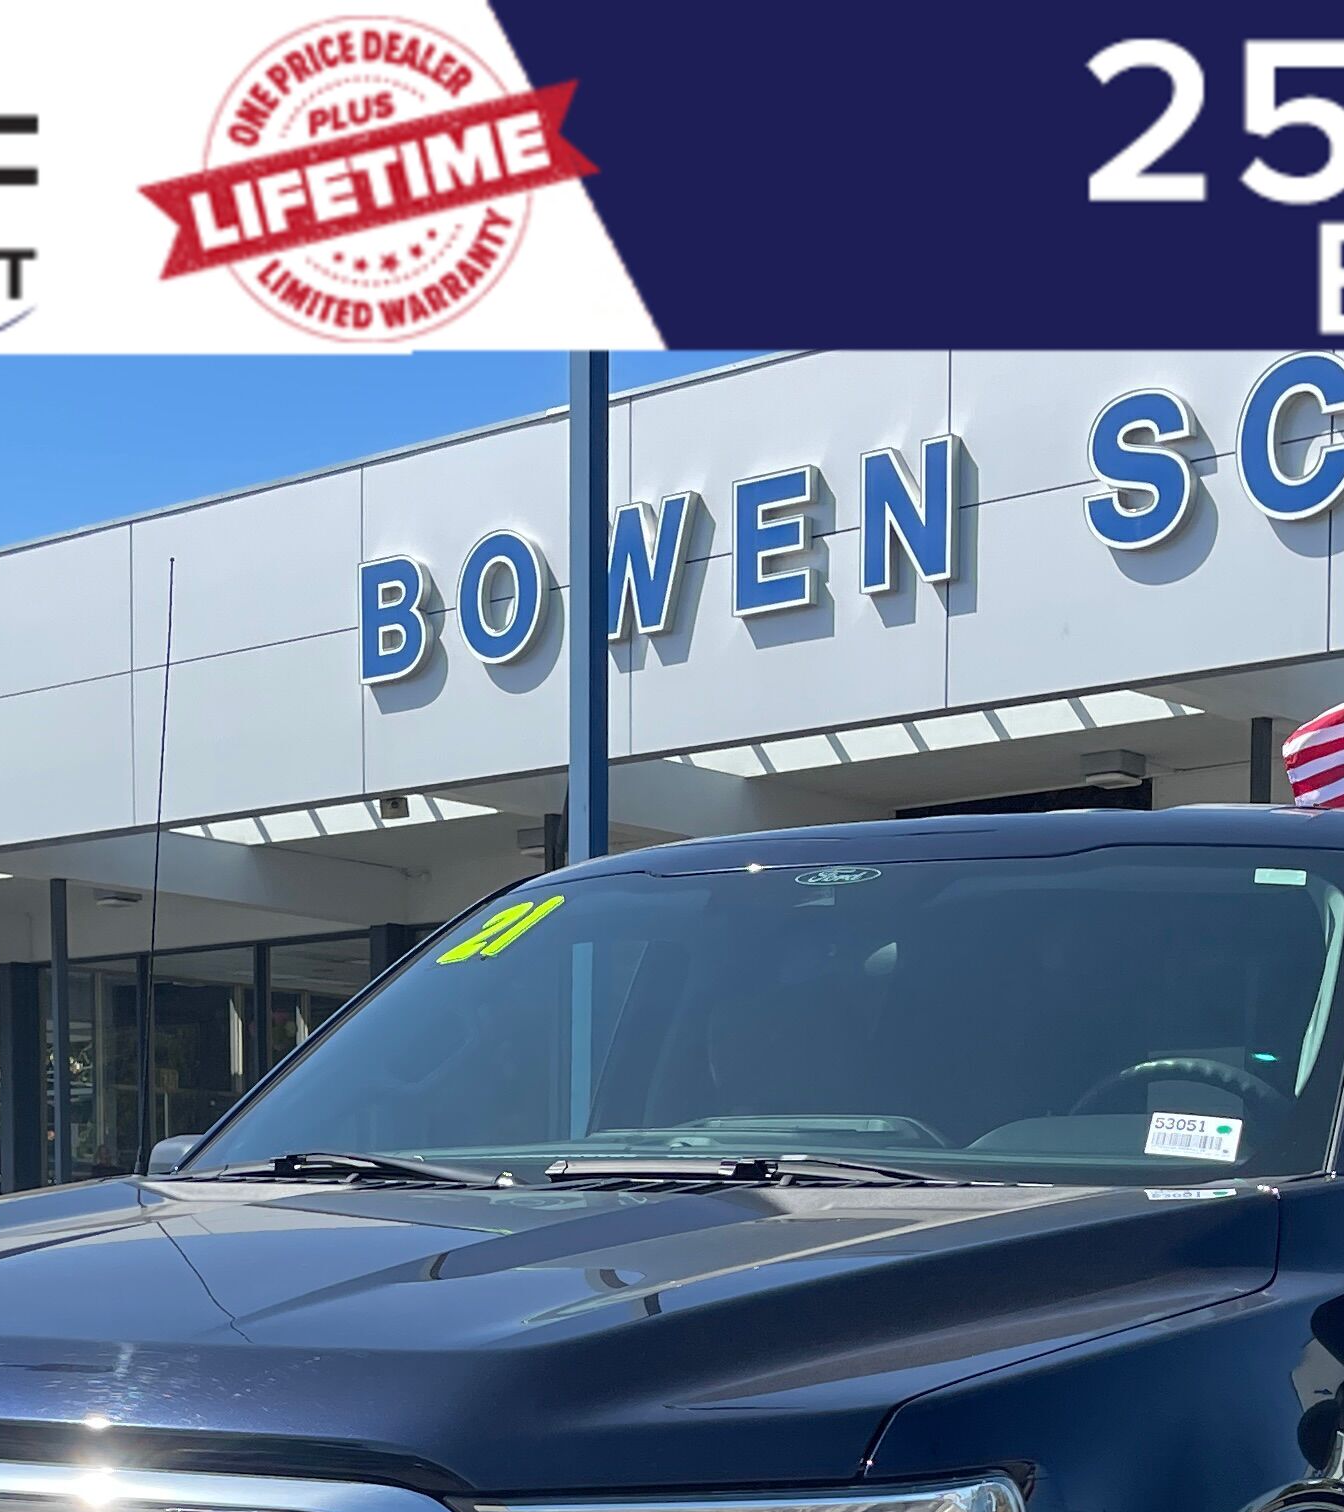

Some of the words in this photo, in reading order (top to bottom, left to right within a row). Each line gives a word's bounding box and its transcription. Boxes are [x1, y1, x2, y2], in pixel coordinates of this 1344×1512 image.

[357, 434, 960, 686] BOWEN
[435, 895, 565, 965] 21
[1154, 1116, 1206, 1134] 53051
